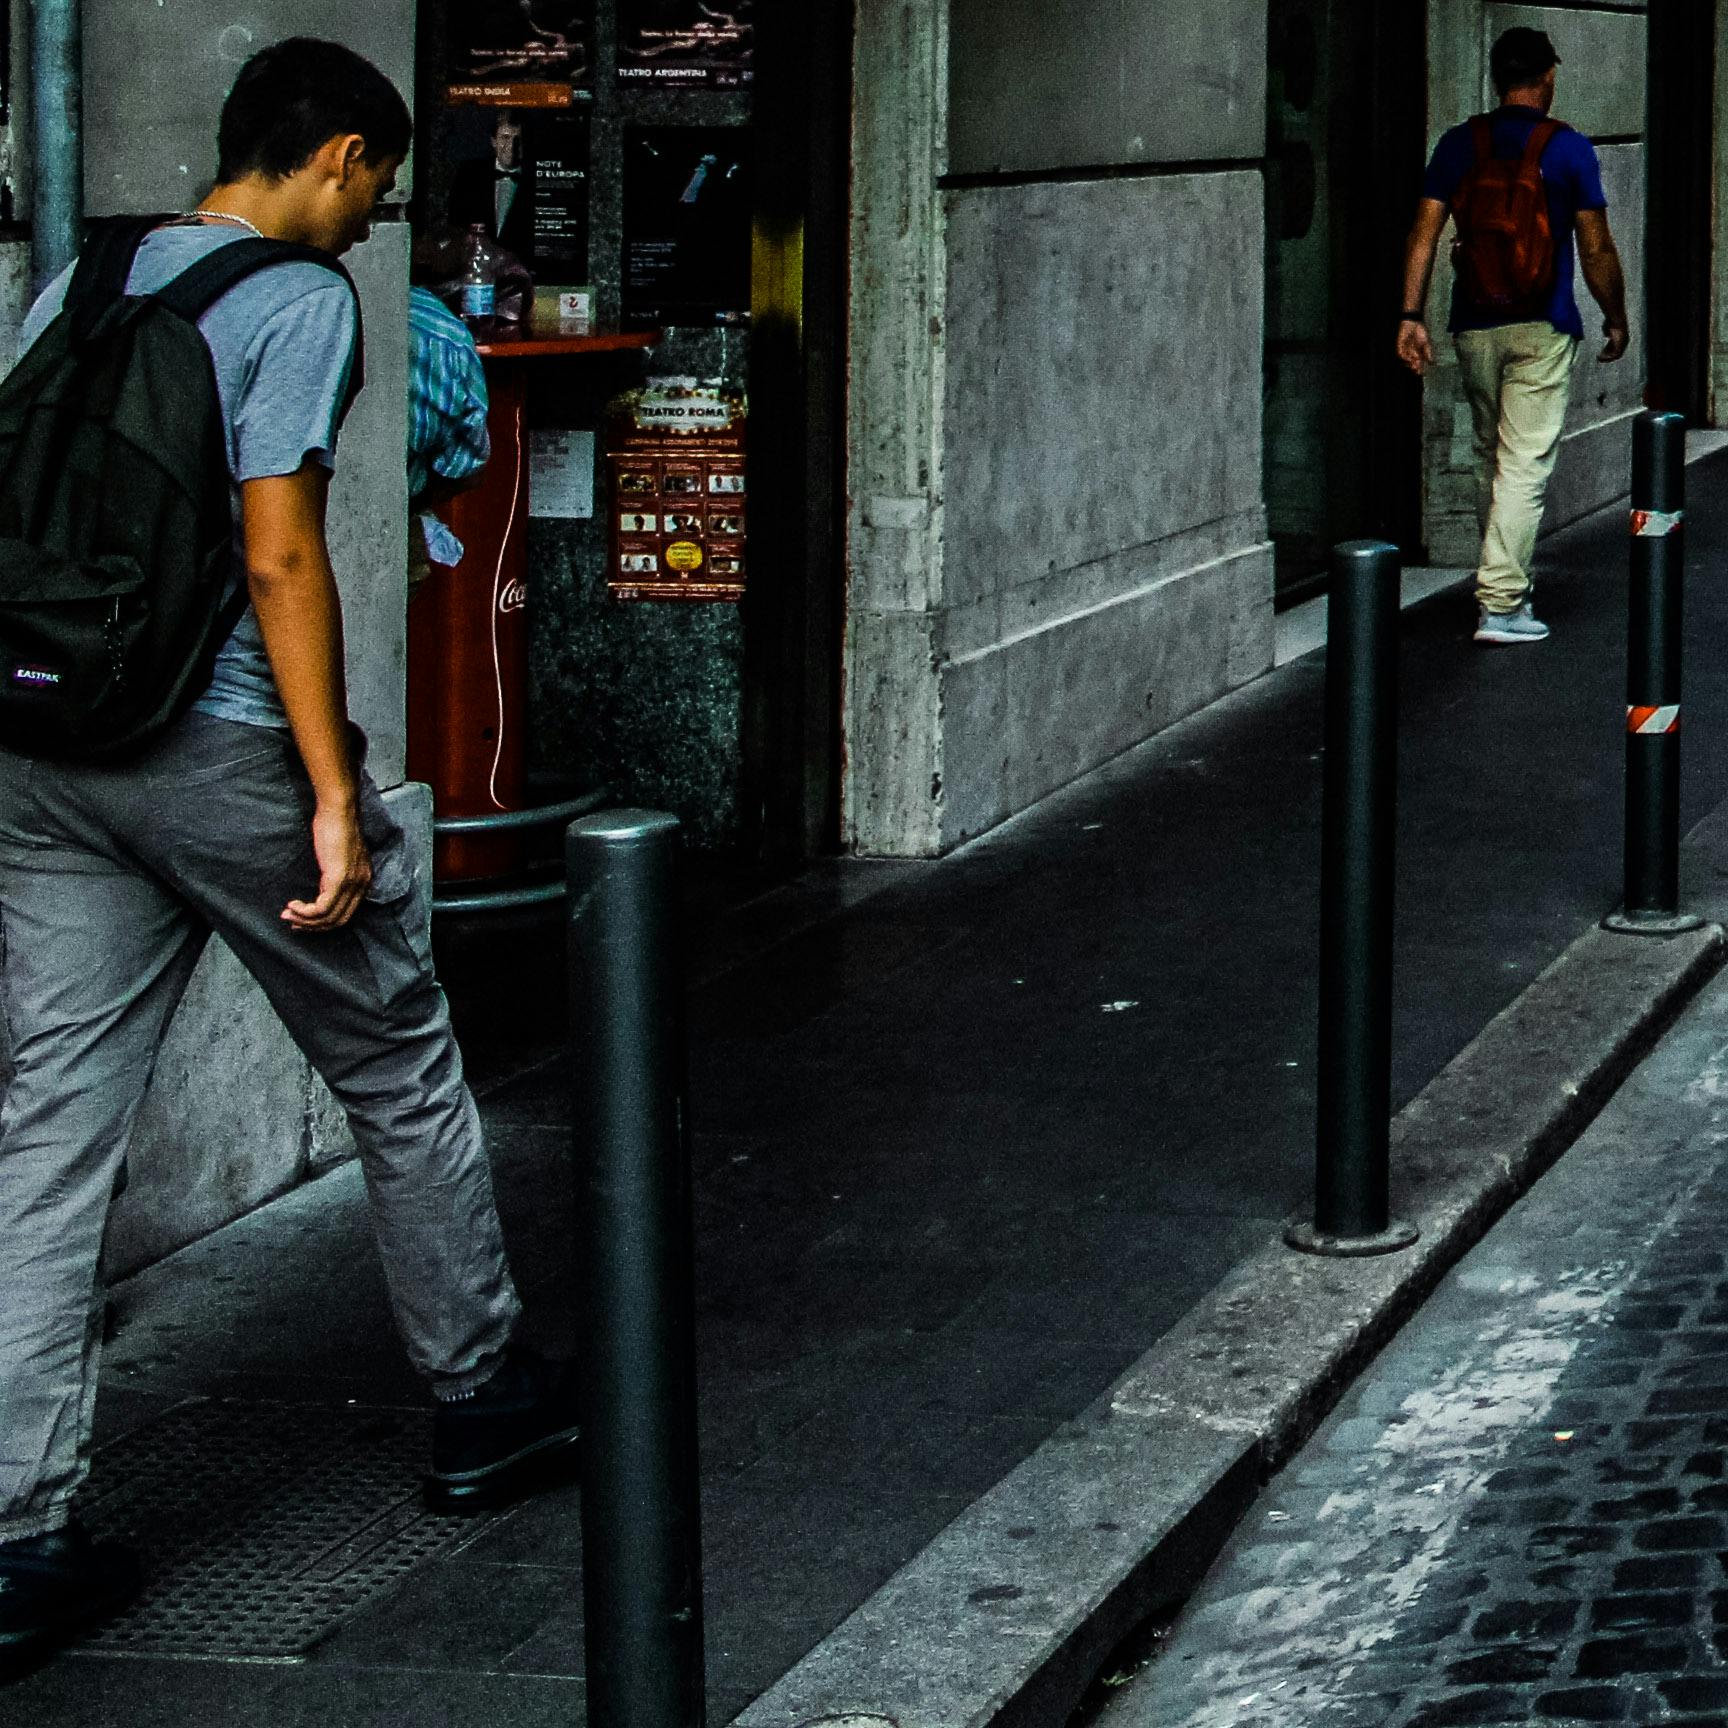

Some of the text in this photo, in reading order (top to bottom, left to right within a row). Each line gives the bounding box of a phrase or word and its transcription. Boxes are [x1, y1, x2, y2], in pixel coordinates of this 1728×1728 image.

[642, 406, 725, 418] TEATRO ROMA
[16, 668, 60, 684] EASTPAK
